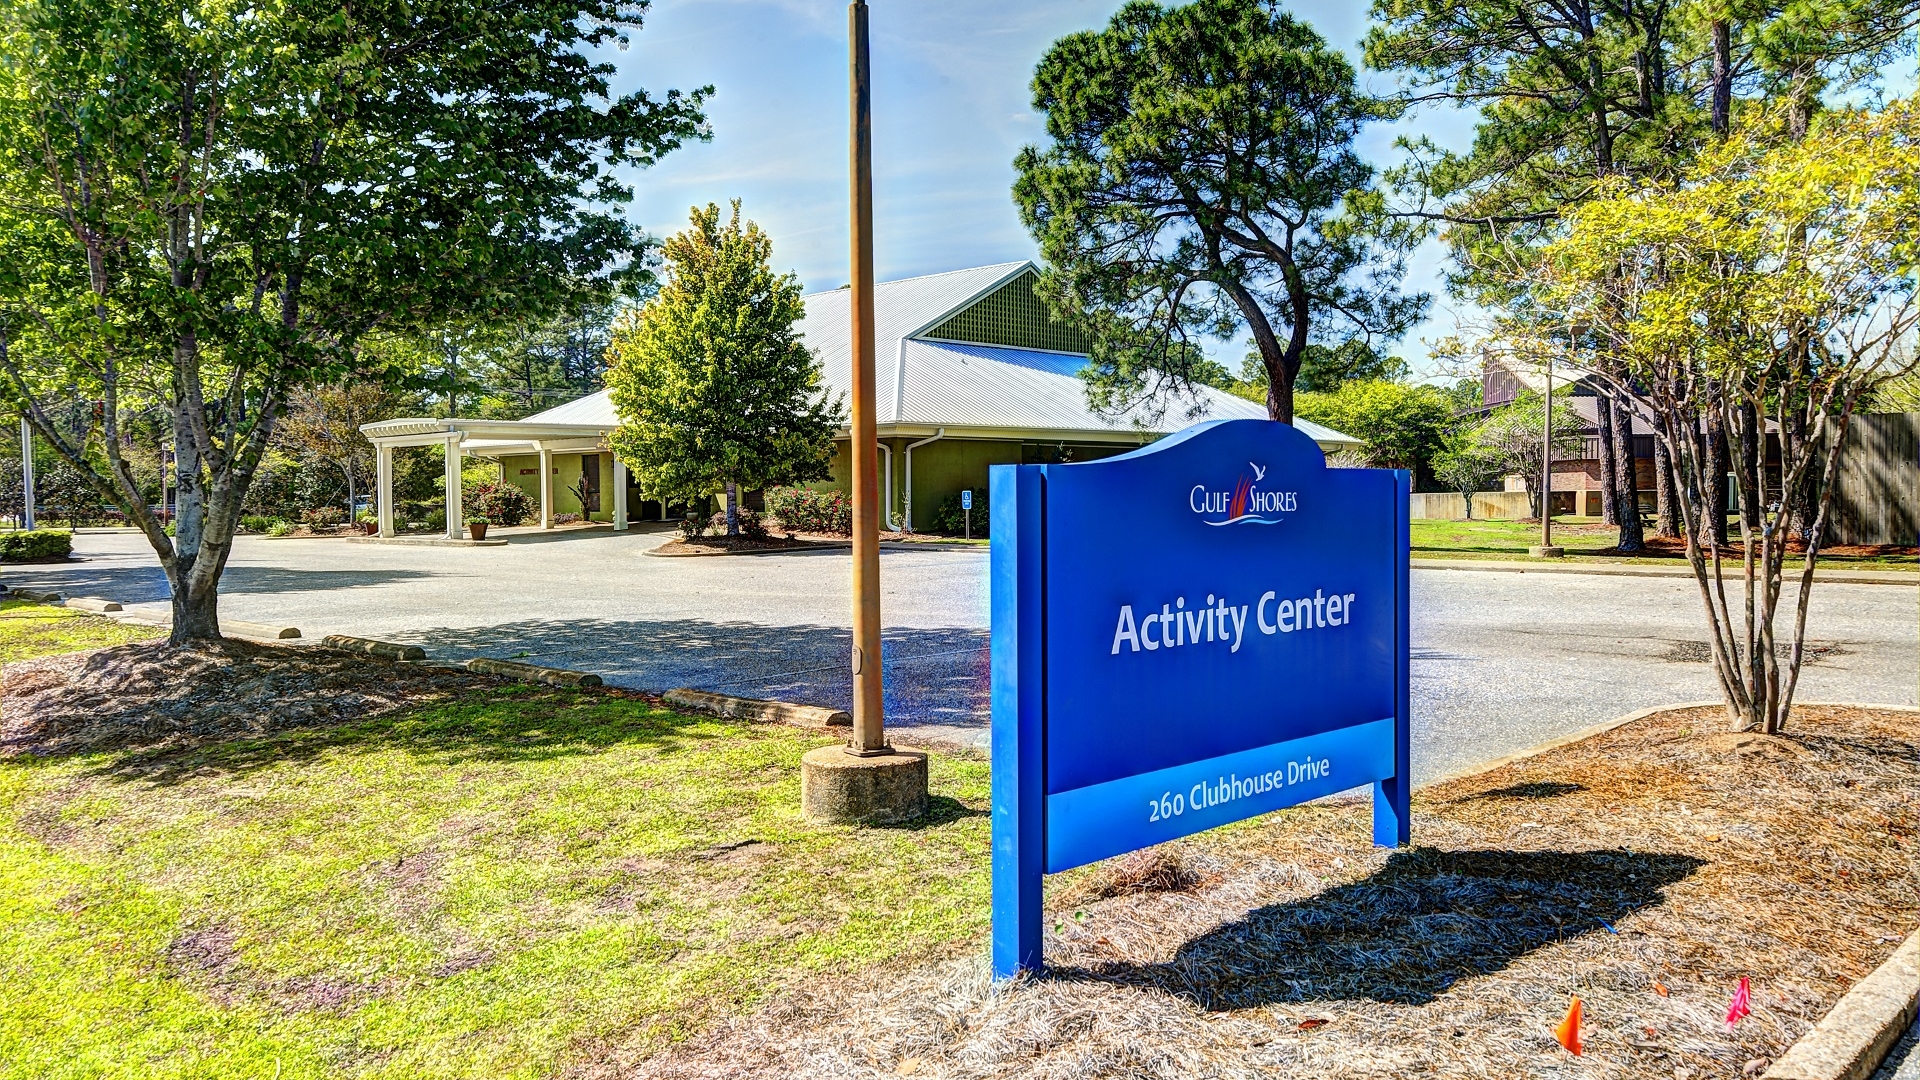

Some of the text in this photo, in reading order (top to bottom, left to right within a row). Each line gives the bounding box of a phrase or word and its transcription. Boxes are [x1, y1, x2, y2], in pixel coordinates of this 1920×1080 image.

[1190, 484, 1297, 513] GULF SHORES
[1111, 588, 1355, 655] Activity Center
[1149, 755, 1330, 823] 260 Clubhouse Drive
